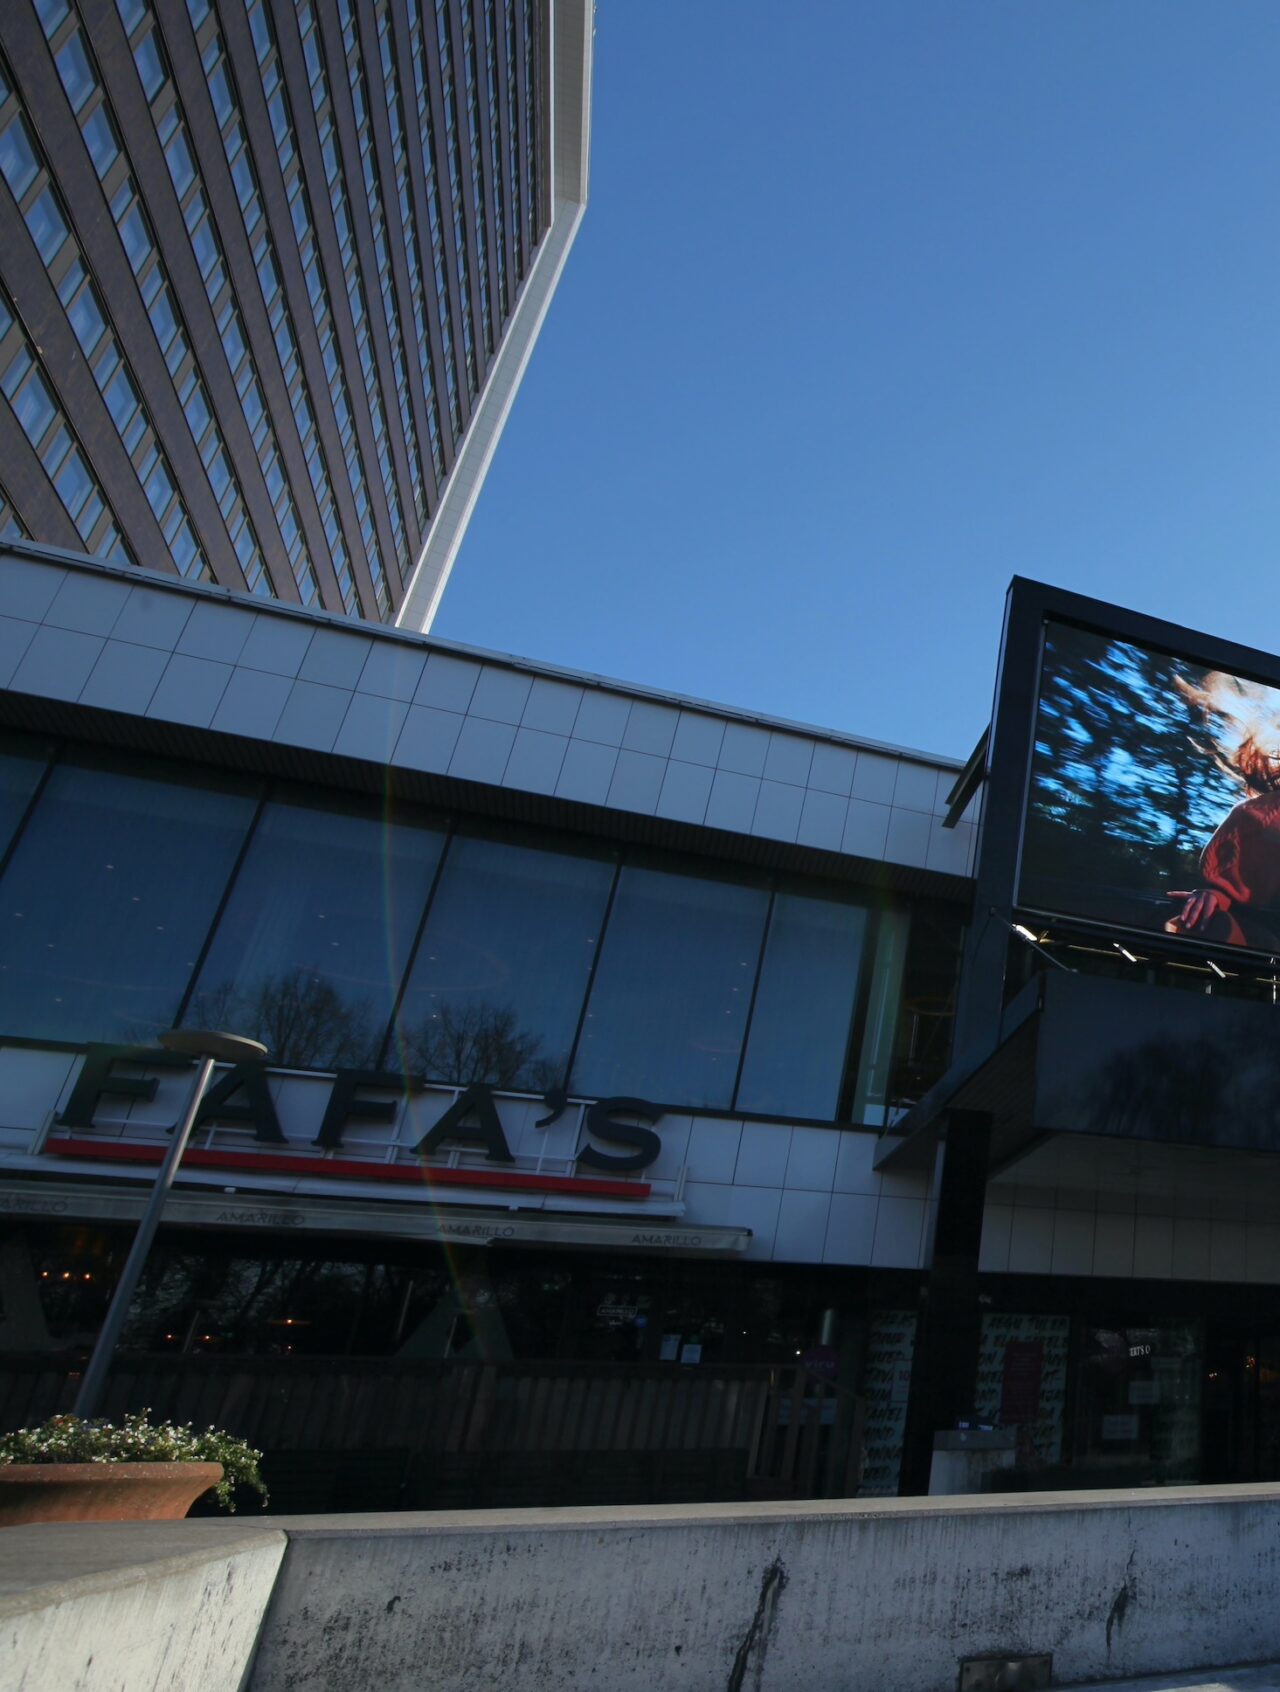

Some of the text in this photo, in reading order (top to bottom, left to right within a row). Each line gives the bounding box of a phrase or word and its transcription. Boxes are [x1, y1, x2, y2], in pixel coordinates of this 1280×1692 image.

[216, 1211, 305, 1226] AMARILLO
[438, 1224, 515, 1238] AMARILLO
[631, 1233, 703, 1247] AMARILLO
